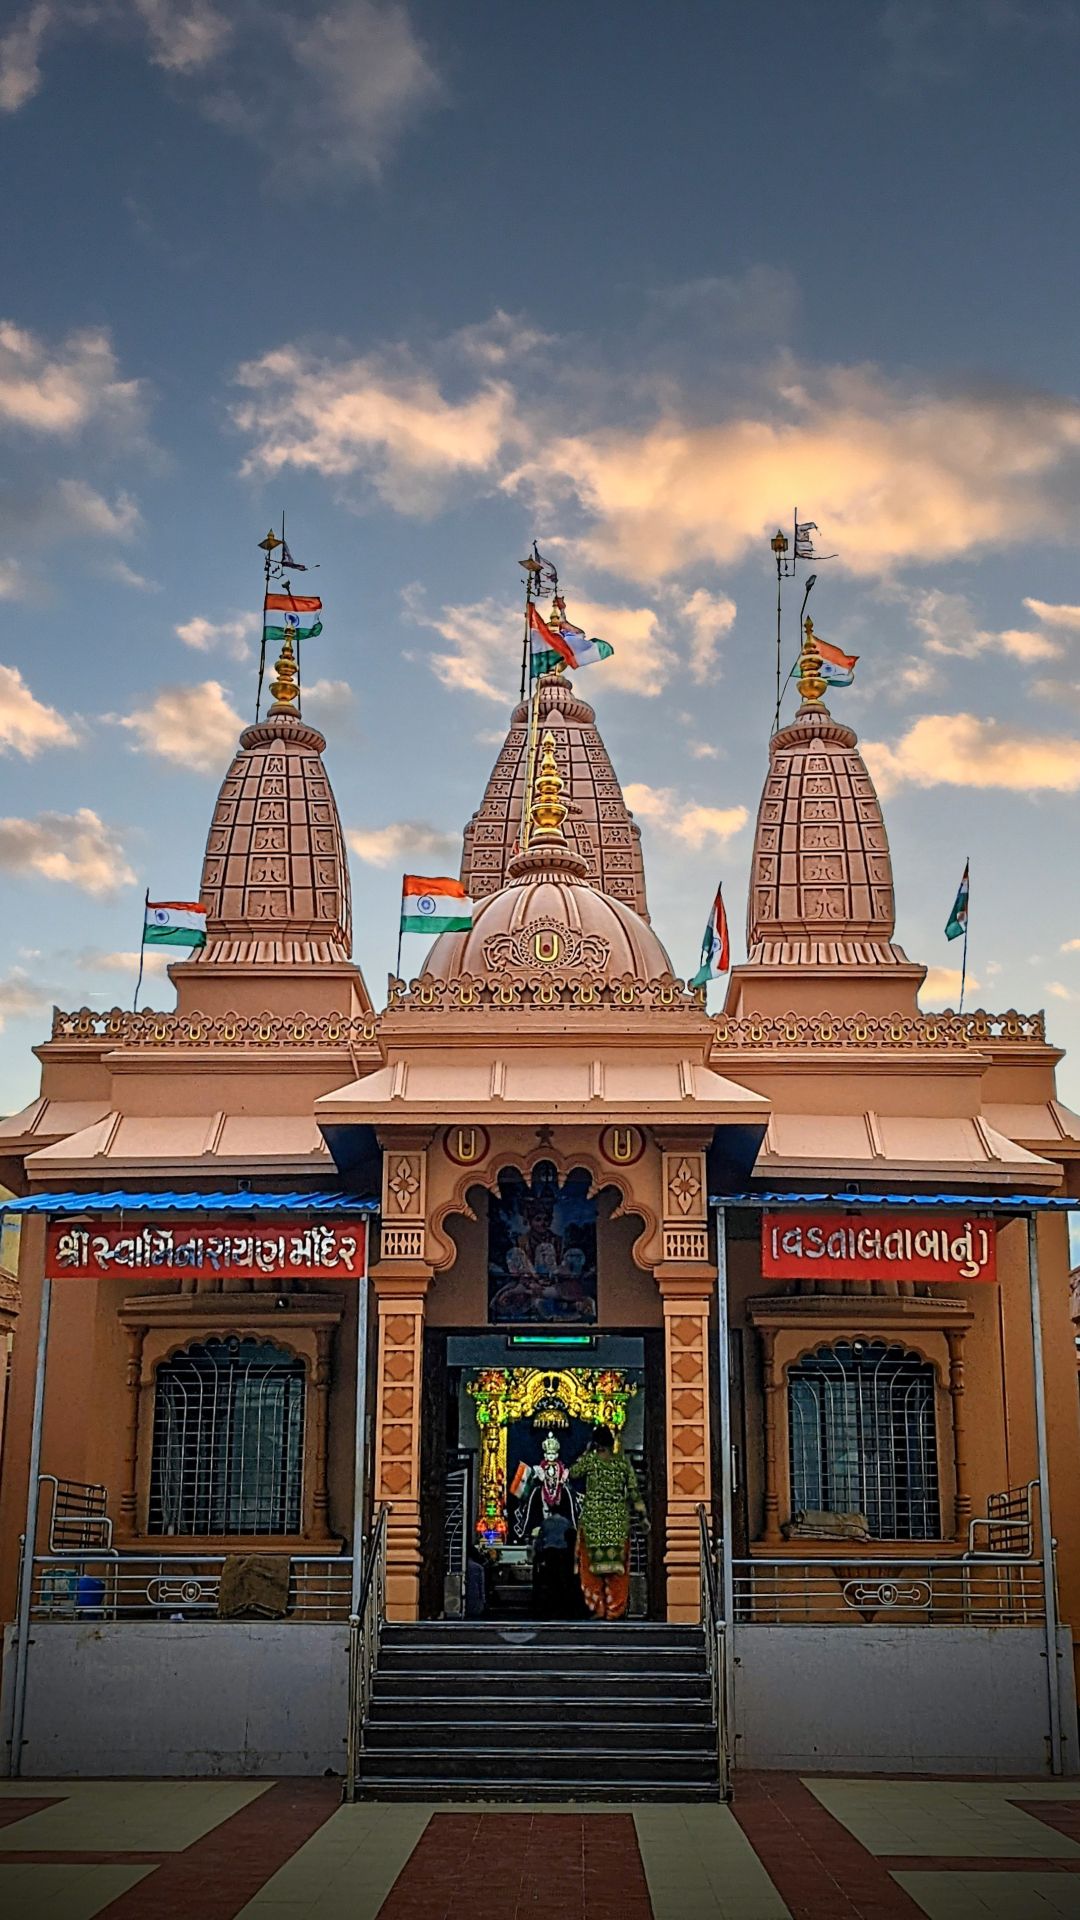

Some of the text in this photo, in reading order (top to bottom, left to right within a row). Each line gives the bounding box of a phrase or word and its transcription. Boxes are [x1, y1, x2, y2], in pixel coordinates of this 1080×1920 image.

[55, 1224, 358, 1272] શ્રી સ્વામિનારાયણ મંદિર
